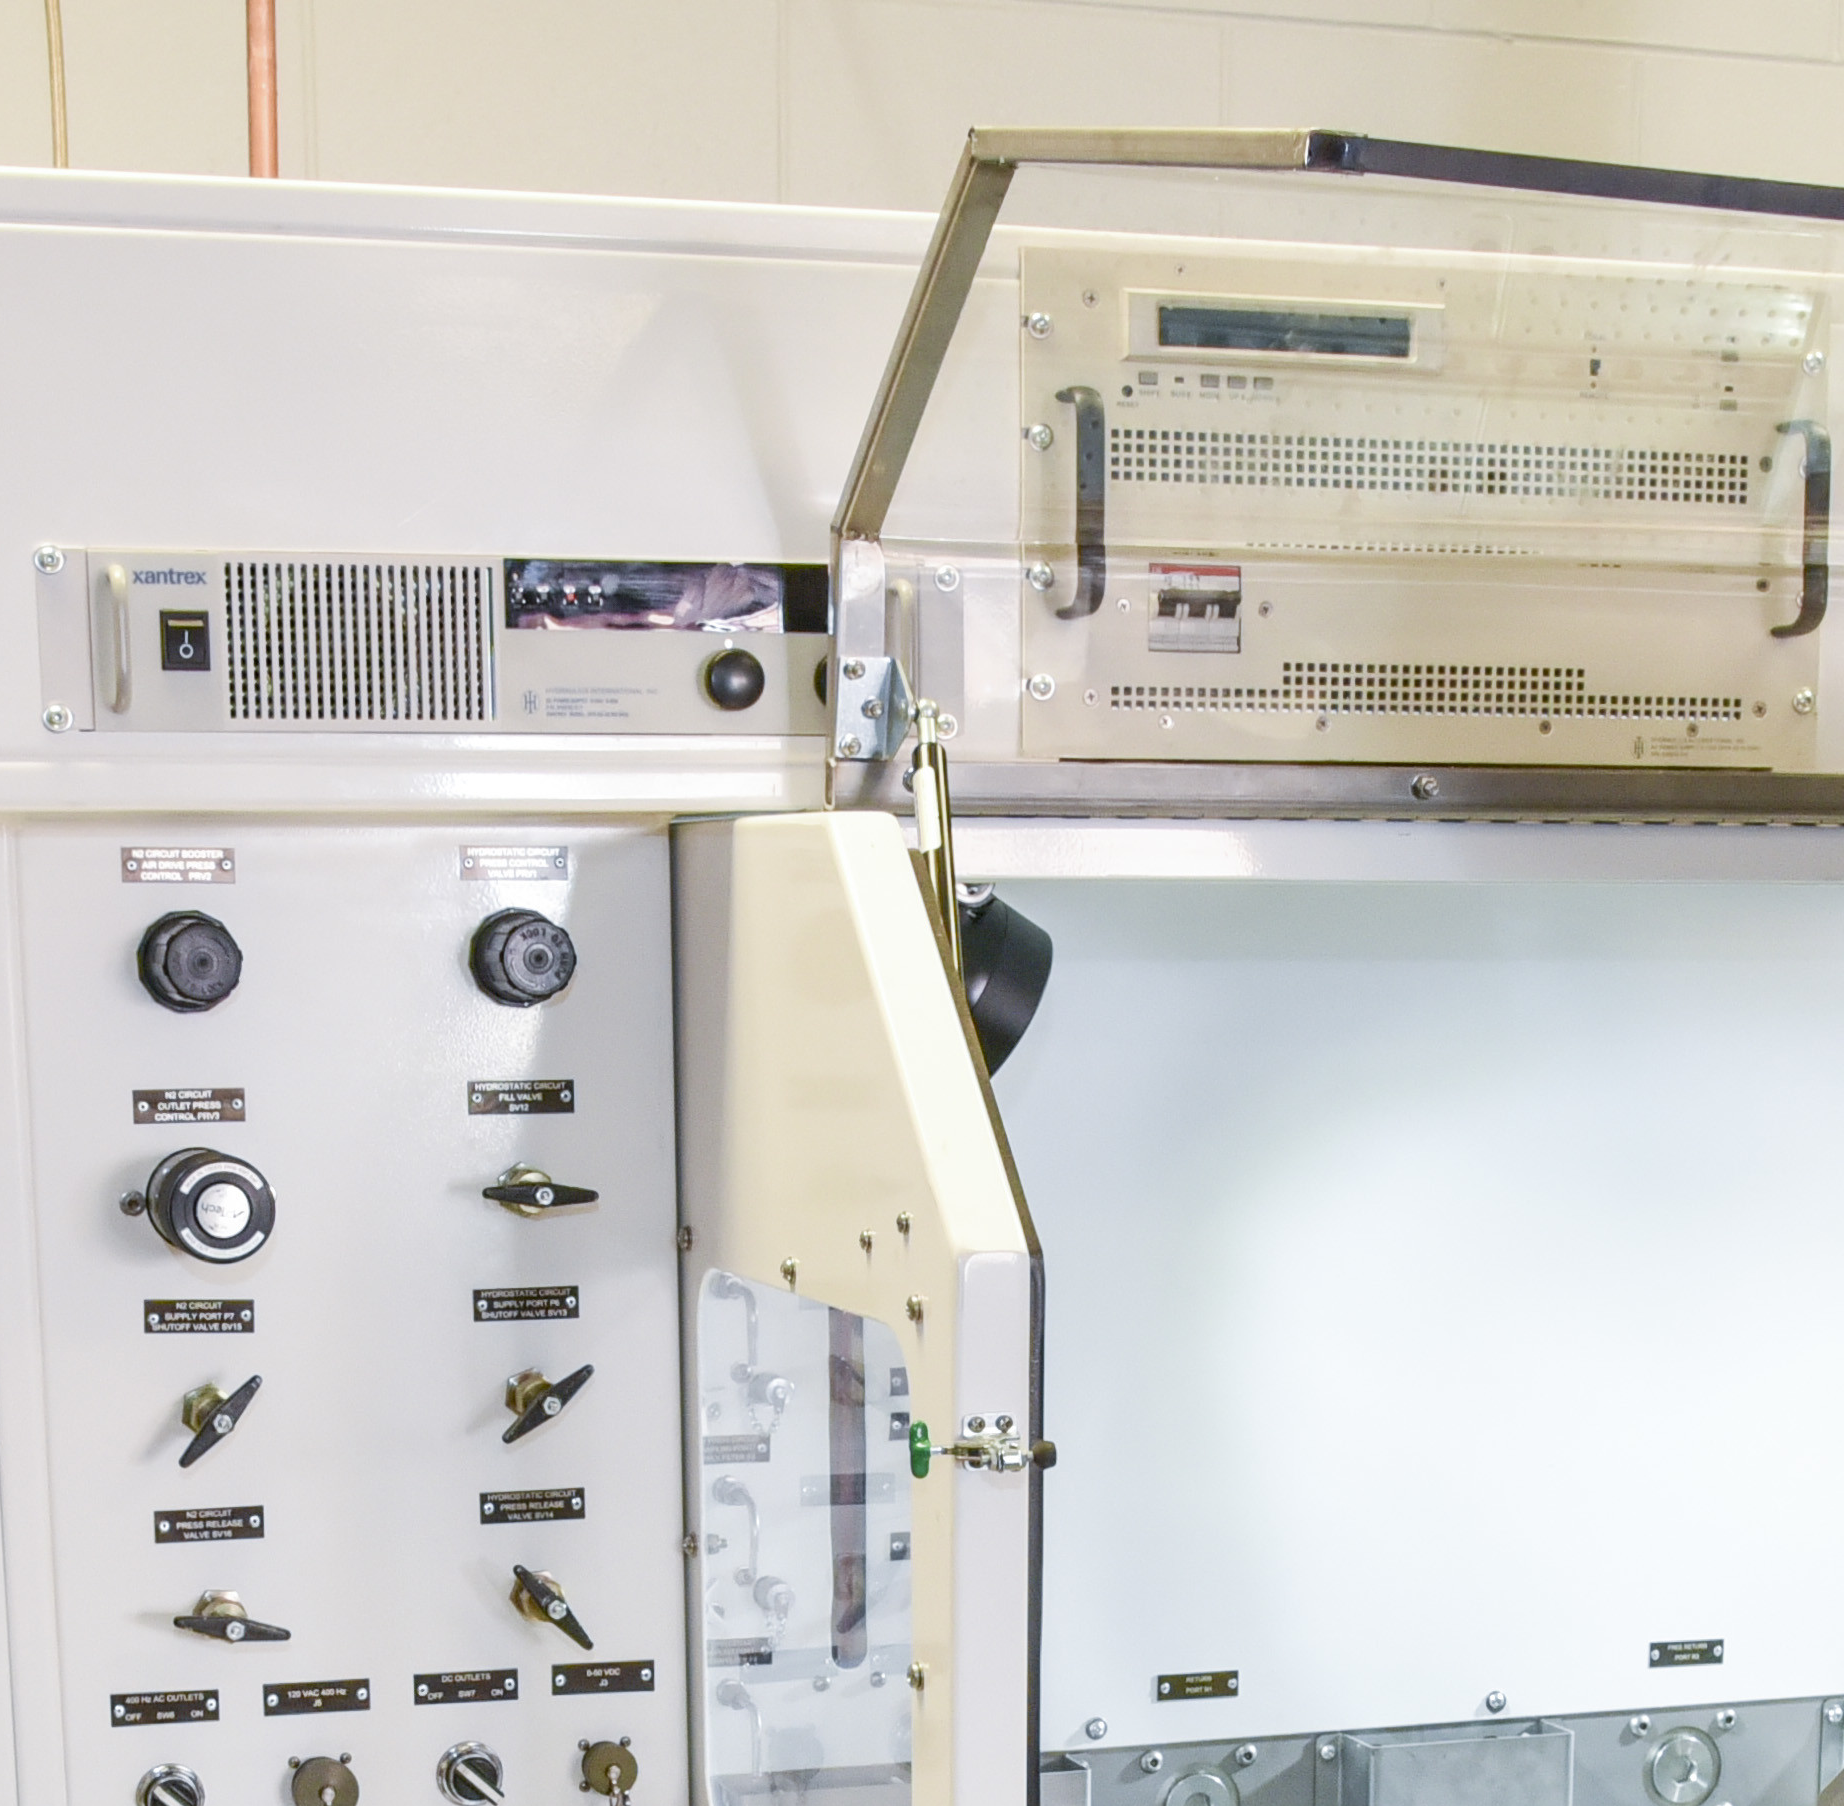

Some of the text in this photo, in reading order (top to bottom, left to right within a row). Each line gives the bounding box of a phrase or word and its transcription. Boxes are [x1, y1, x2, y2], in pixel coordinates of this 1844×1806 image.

[132, 568, 207, 585] xantrex
[475, 1082, 566, 1091] HYDROSTATIC CIRCUIT
[178, 1090, 212, 1099] CIRCUIT
[499, 1093, 543, 1101] FILL VALVE
[158, 1101, 221, 1110] OUTLET PRESS
[155, 1113, 196, 1121] CONTROL
